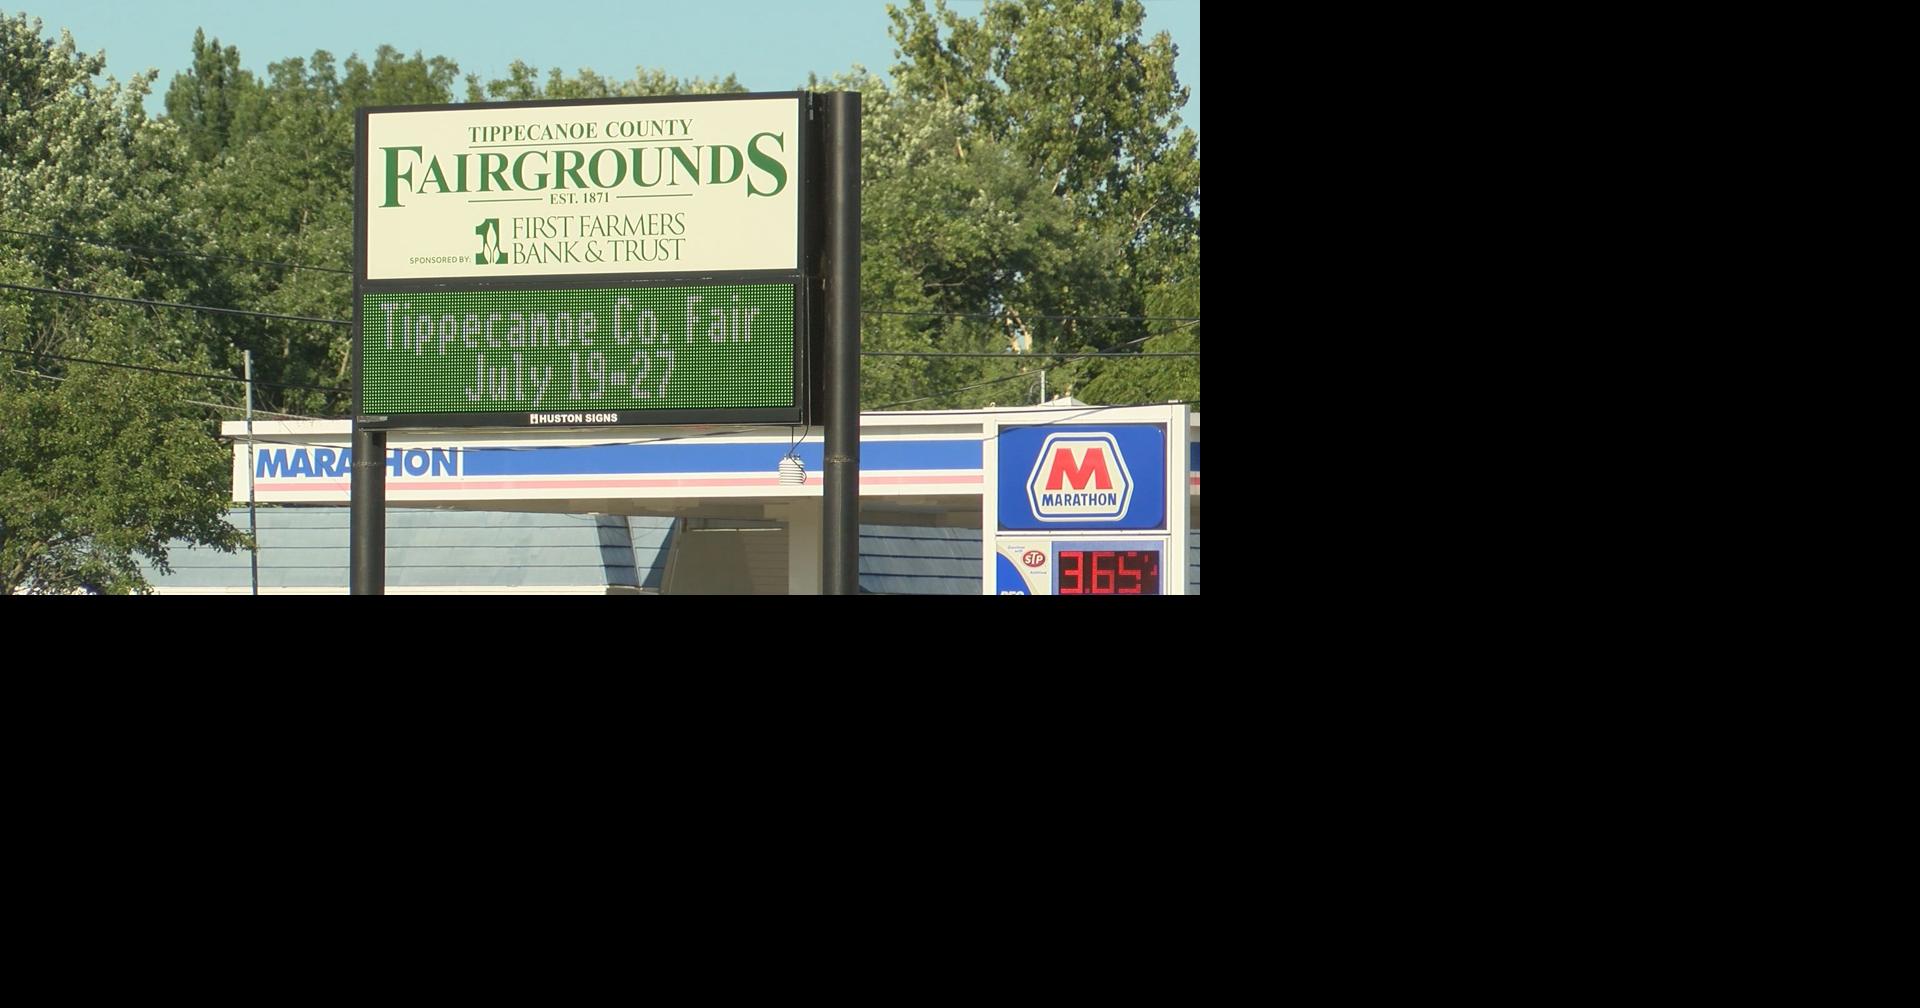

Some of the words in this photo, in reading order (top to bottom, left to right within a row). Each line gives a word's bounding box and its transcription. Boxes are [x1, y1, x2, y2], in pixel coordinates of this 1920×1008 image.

[468, 122, 598, 143] TIPPECANOE
[605, 118, 694, 138] COUNTY
[378, 131, 788, 208] FAIRGROUNDS
[550, 193, 579, 205] EST.
[583, 192, 609, 204] 1871
[513, 216, 575, 239] FIRST
[580, 212, 686, 238] FARMERS
[409, 256, 458, 264] SPONSORED
[458, 256, 472, 264] BY:
[513, 242, 582, 264] BANK
[585, 241, 603, 263] &
[607, 238, 686, 262] TRUST
[379, 303, 598, 356] Tippecanoe
[613, 296, 669, 345] Co.
[686, 292, 761, 344] Fair
[465, 350, 553, 407] July
[568, 350, 675, 400] 19-27
[540, 414, 583, 423] HUSTON
[585, 413, 618, 423] SIGNS
[256, 446, 458, 478] MARAHON
[1045, 447, 1114, 490] M
[1041, 493, 1117, 507] MARATHON
[1025, 552, 1044, 565] STP
